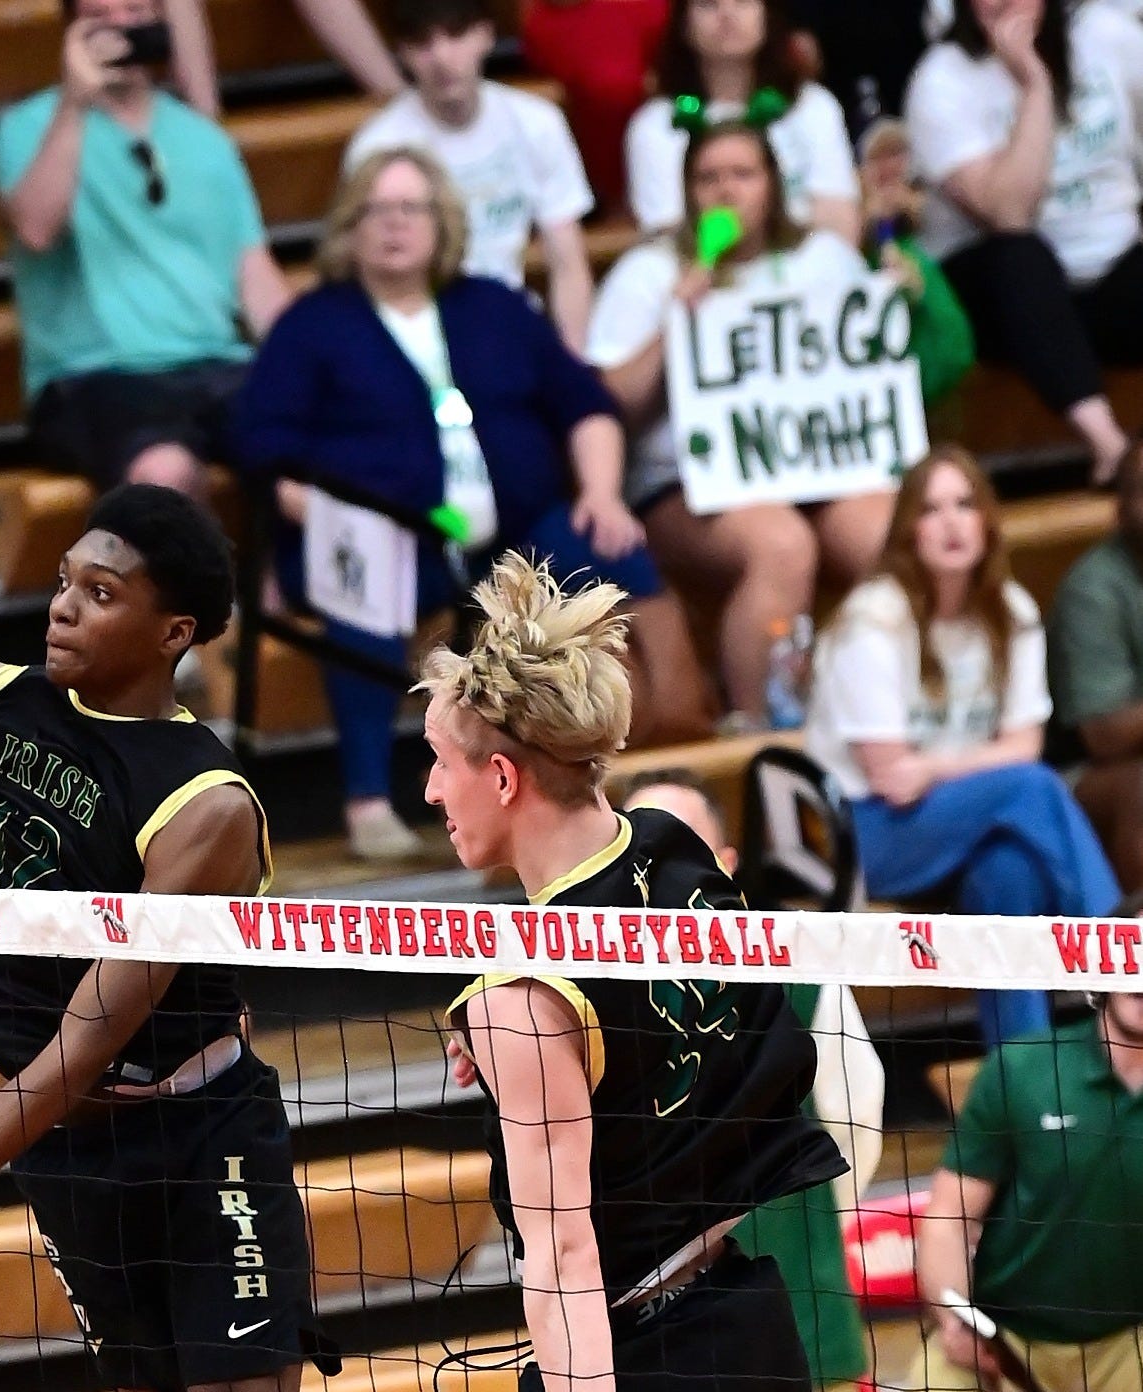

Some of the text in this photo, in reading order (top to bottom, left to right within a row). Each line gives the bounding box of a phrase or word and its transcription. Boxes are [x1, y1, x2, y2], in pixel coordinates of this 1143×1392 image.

[838, 288, 911, 368] GO
[229, 901, 792, 968] WITTENBERG VOLLEYBALL
[1051, 923, 1143, 974] WIT
[217, 1156, 269, 1299] IRISH
